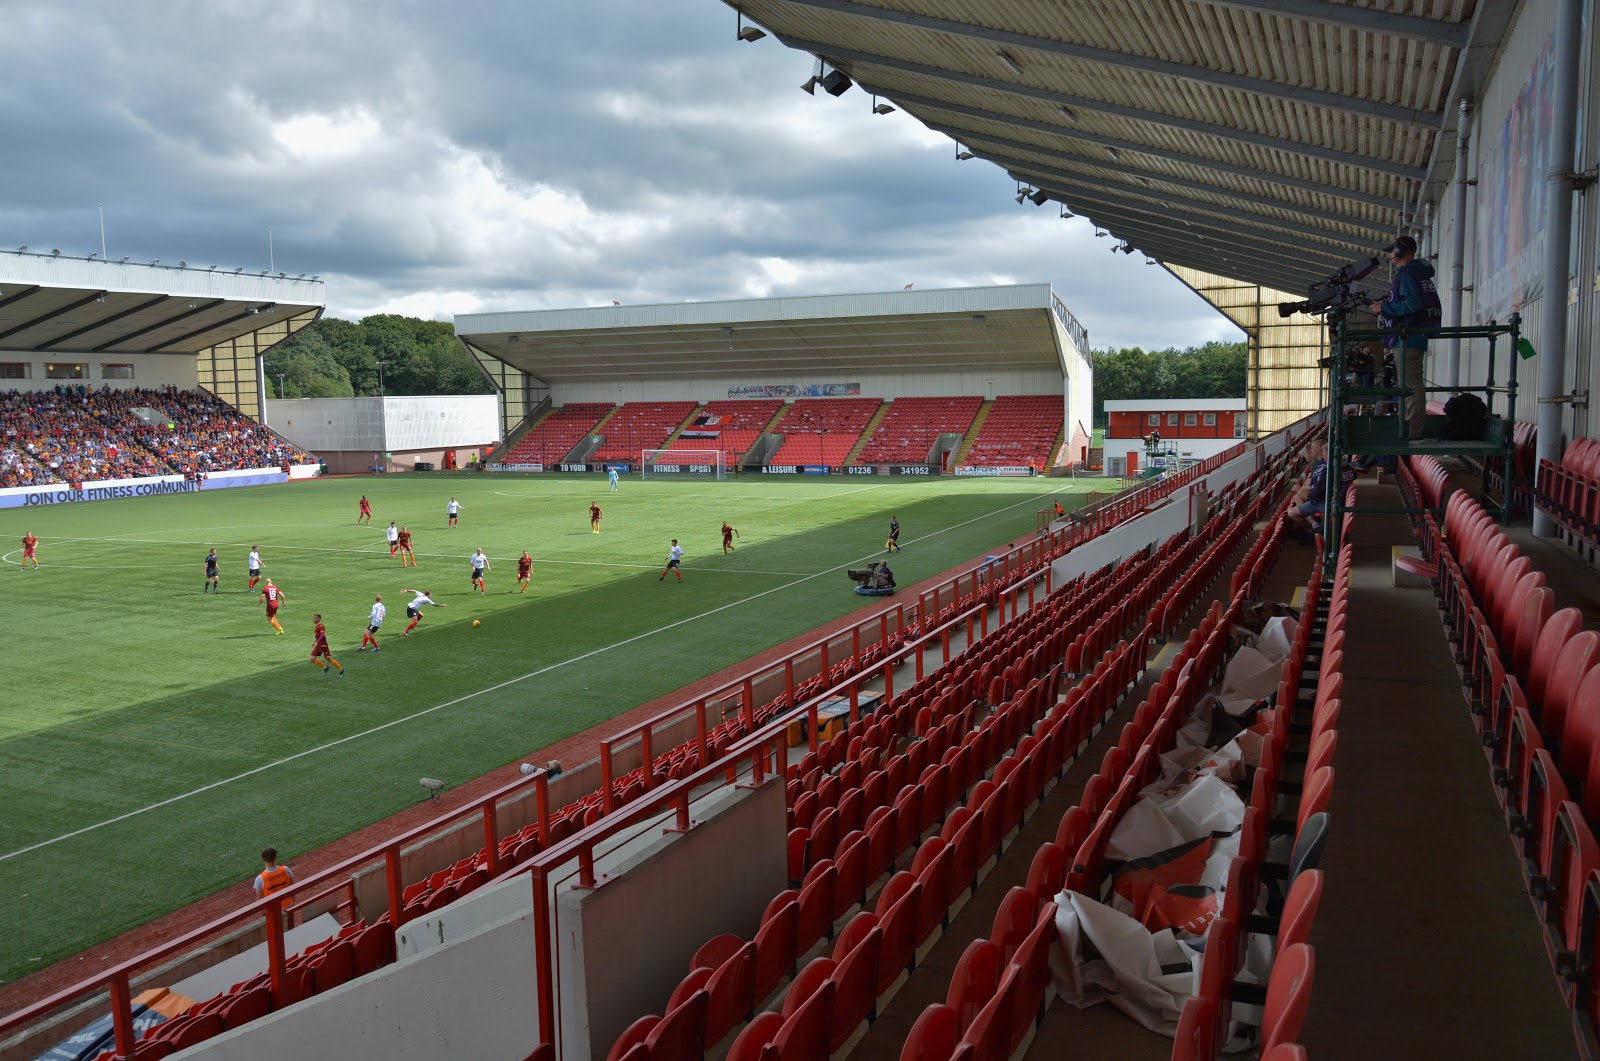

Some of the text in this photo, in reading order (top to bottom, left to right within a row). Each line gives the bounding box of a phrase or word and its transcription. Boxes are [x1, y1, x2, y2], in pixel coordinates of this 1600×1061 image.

[560, 464, 569, 472] TO
[569, 464, 586, 472] YOUR
[653, 464, 712, 473] FITNESS SPORT
[768, 465, 797, 474] LEISURE
[848, 466, 872, 474] 01236
[900, 466, 929, 475] 341952
[23, 492, 54, 506] JOIN
[57, 489, 84, 503] OUR
[88, 485, 133, 501] FITNESS
